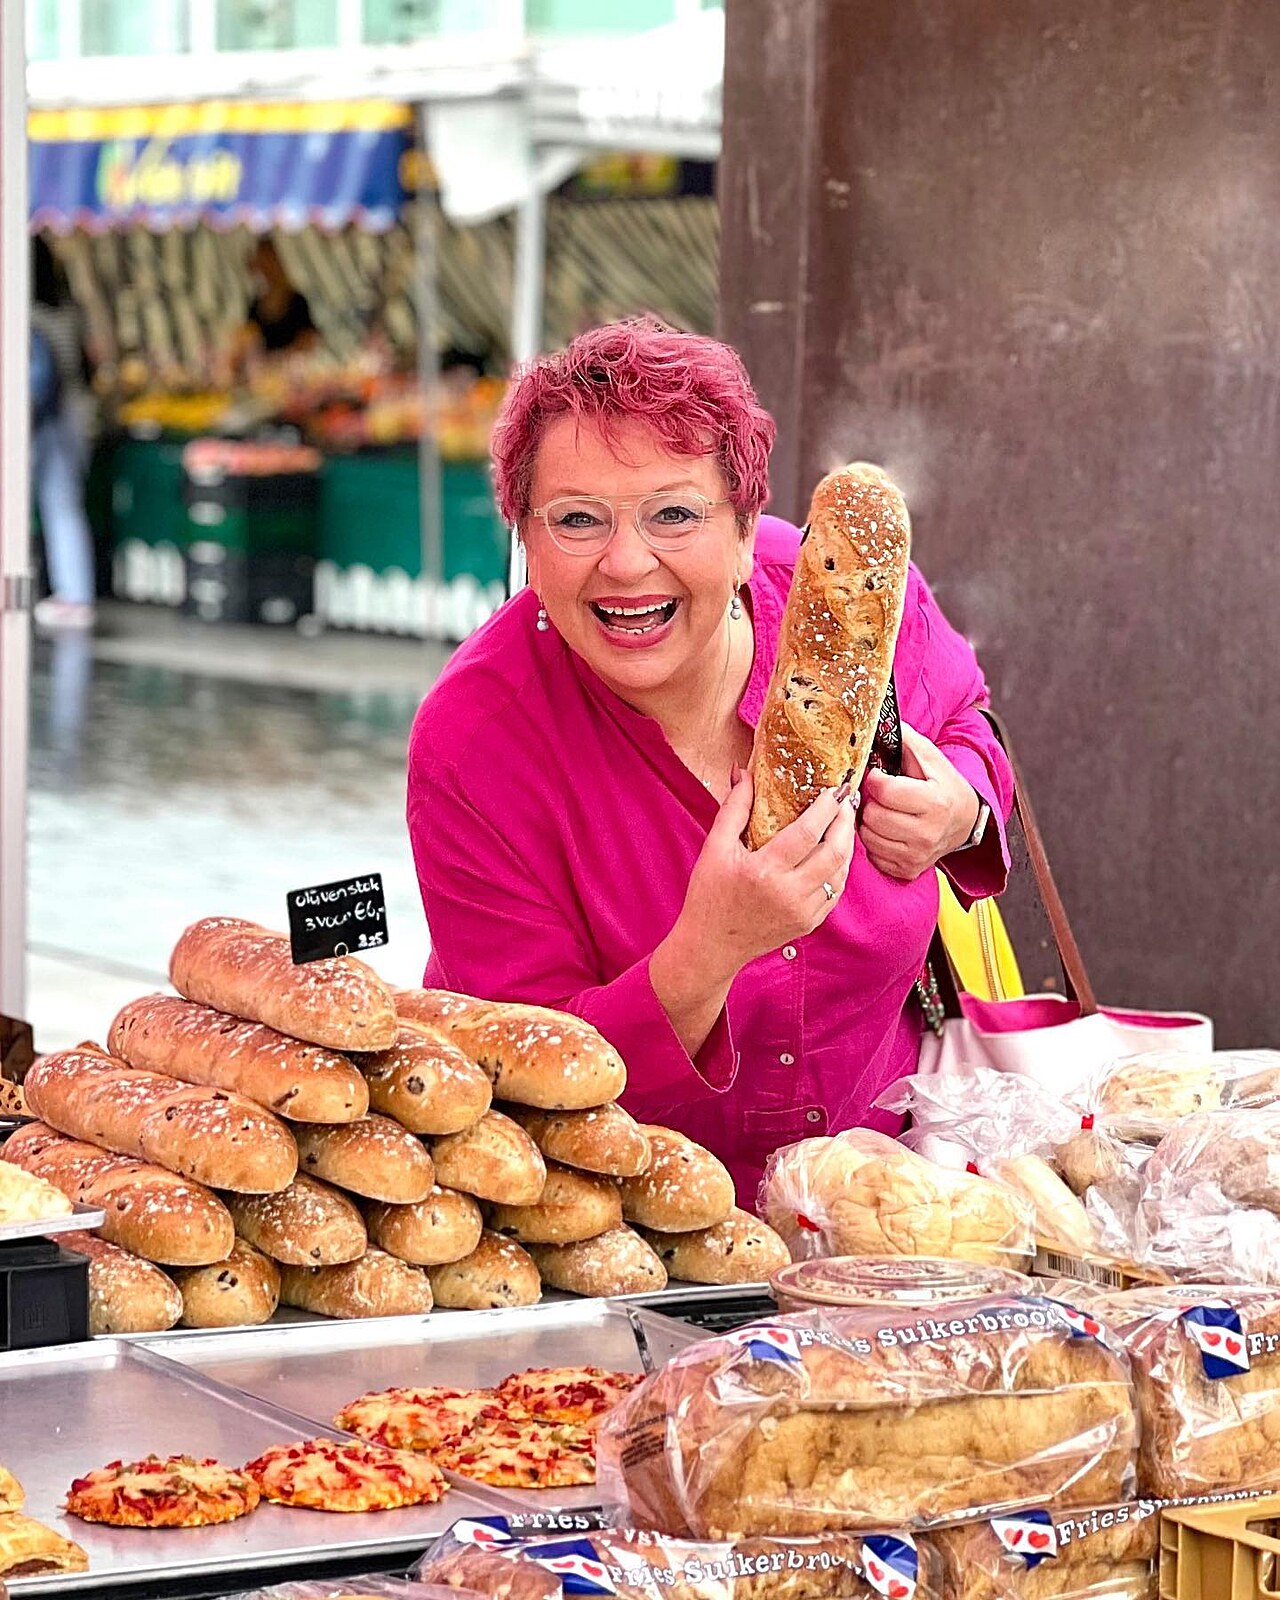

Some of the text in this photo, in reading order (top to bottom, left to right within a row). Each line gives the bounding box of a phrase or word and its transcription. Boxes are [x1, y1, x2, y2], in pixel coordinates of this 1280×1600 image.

[305, 918, 316, 932] 3
[511, 1513, 590, 1530] Fries
[1055, 1506, 1129, 1546] Fries
[606, 1558, 675, 1586] Fries
